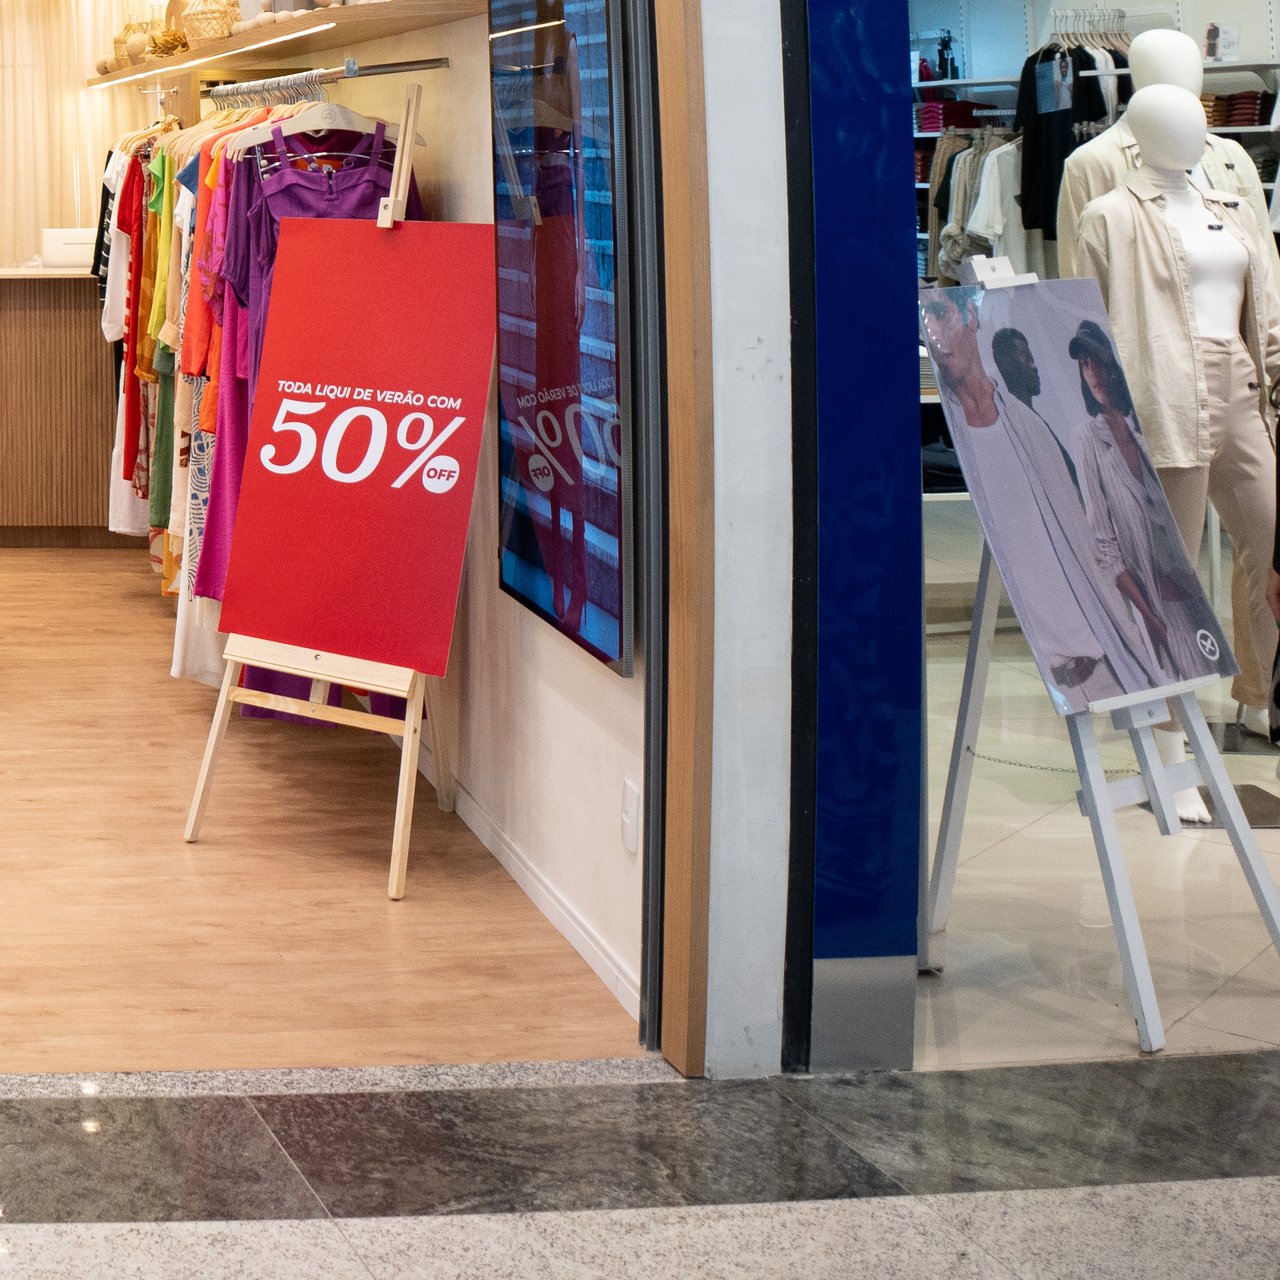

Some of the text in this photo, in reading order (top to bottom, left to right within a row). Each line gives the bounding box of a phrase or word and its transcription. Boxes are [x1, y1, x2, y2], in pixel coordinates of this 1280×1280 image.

[277, 380, 462, 410] TODA LIQUI DE VERÃO COM
[259, 398, 467, 494] 50%
[426, 467, 456, 481] OFF
